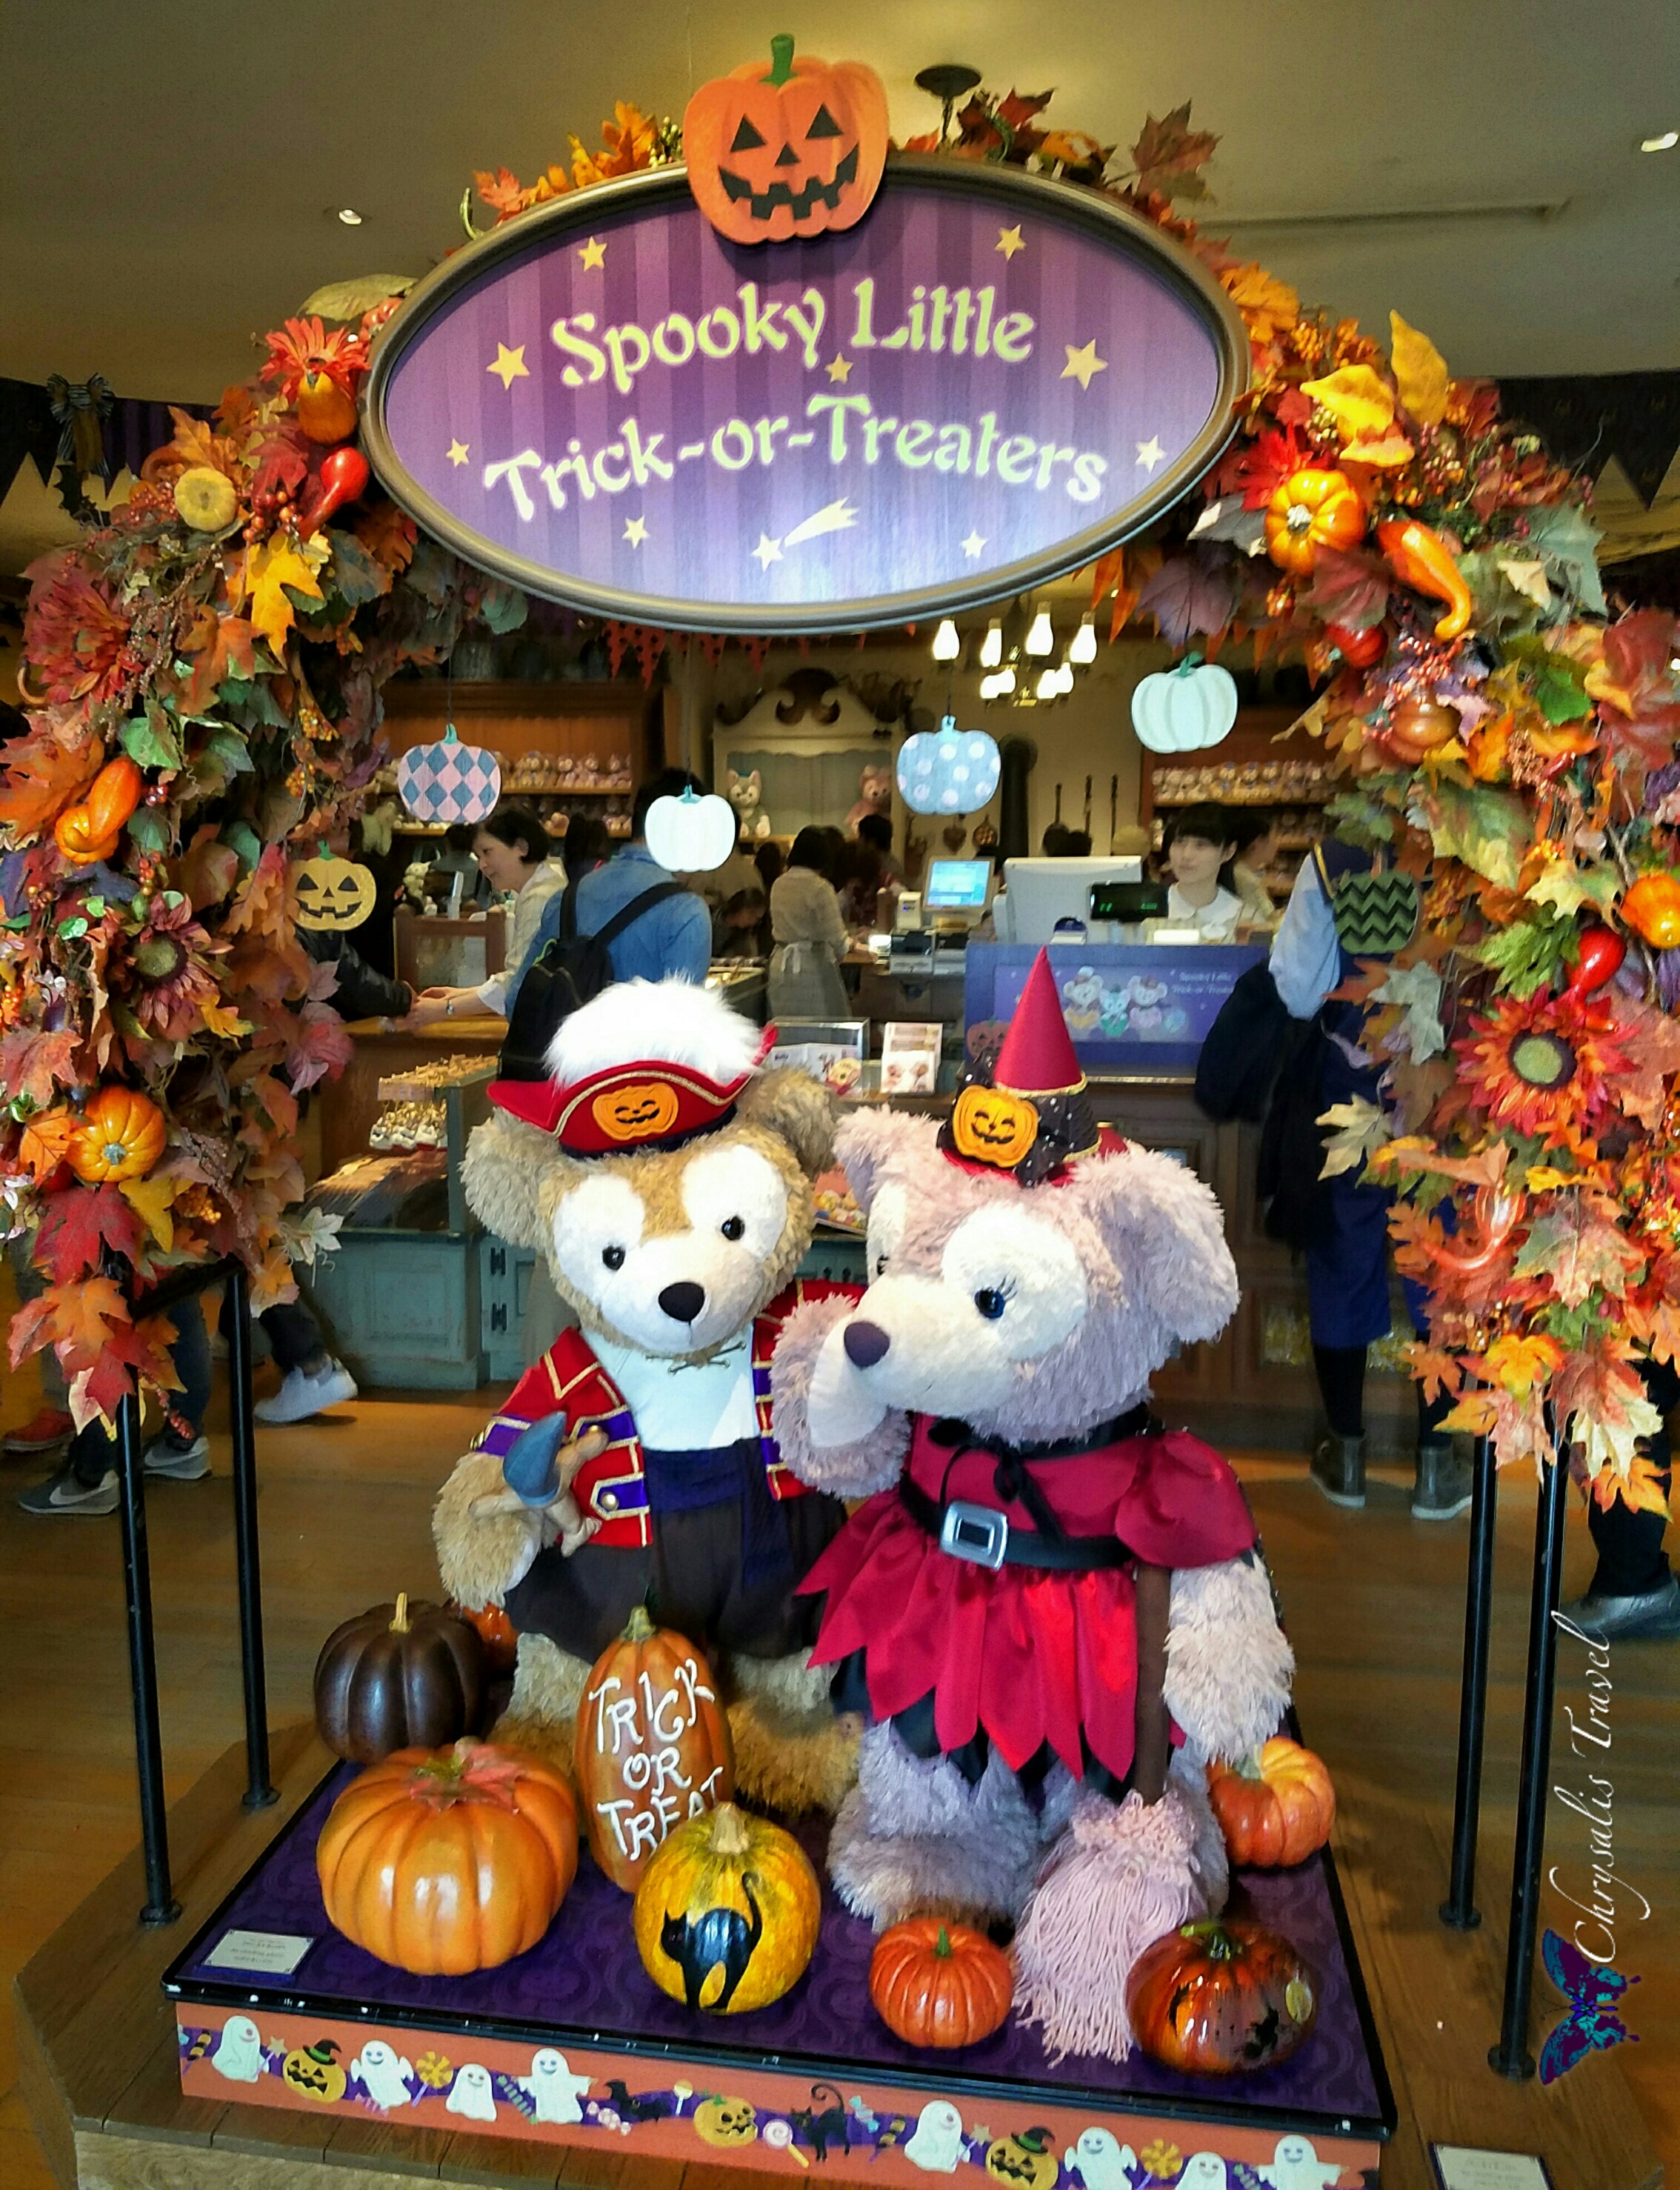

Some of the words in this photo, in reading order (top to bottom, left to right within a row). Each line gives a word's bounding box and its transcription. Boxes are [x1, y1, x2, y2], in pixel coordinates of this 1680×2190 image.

[551, 281, 826, 394] Spooky
[850, 276, 1036, 362] Little
[483, 392, 1109, 522] Trick-or-Treaters
[588, 1658, 716, 1754] TRICK
[596, 1766, 724, 1861] TREAT
[622, 1746, 693, 1797] OR
